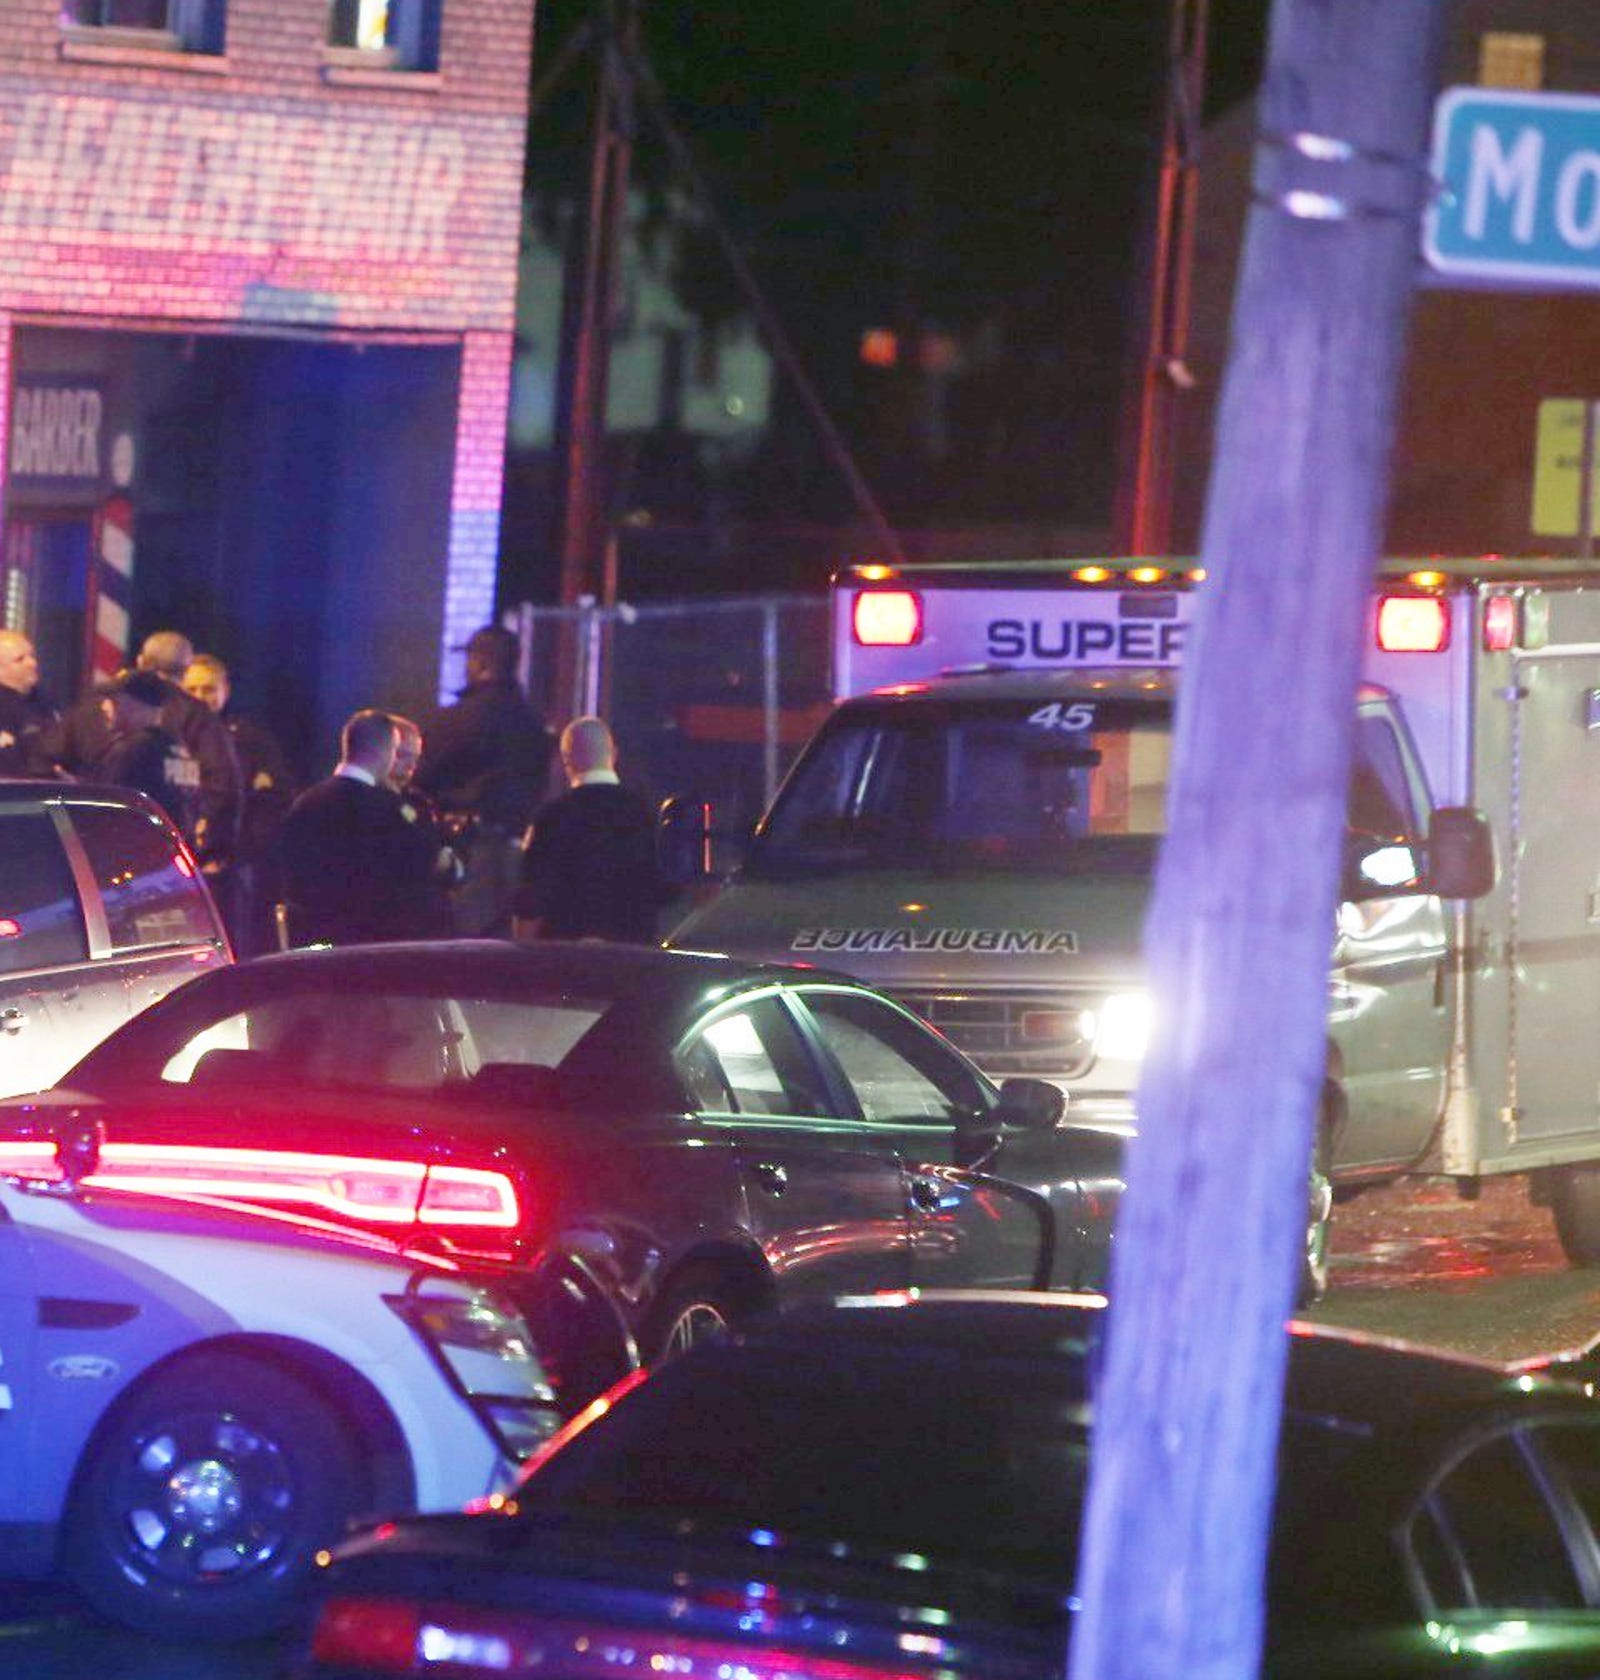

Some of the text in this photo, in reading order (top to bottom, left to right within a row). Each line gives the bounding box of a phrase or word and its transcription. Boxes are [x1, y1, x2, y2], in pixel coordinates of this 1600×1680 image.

[0, 93, 464, 268] HEALTHY HAIR
[11, 387, 101, 477] BARBER
[1027, 703, 1096, 731] 45
